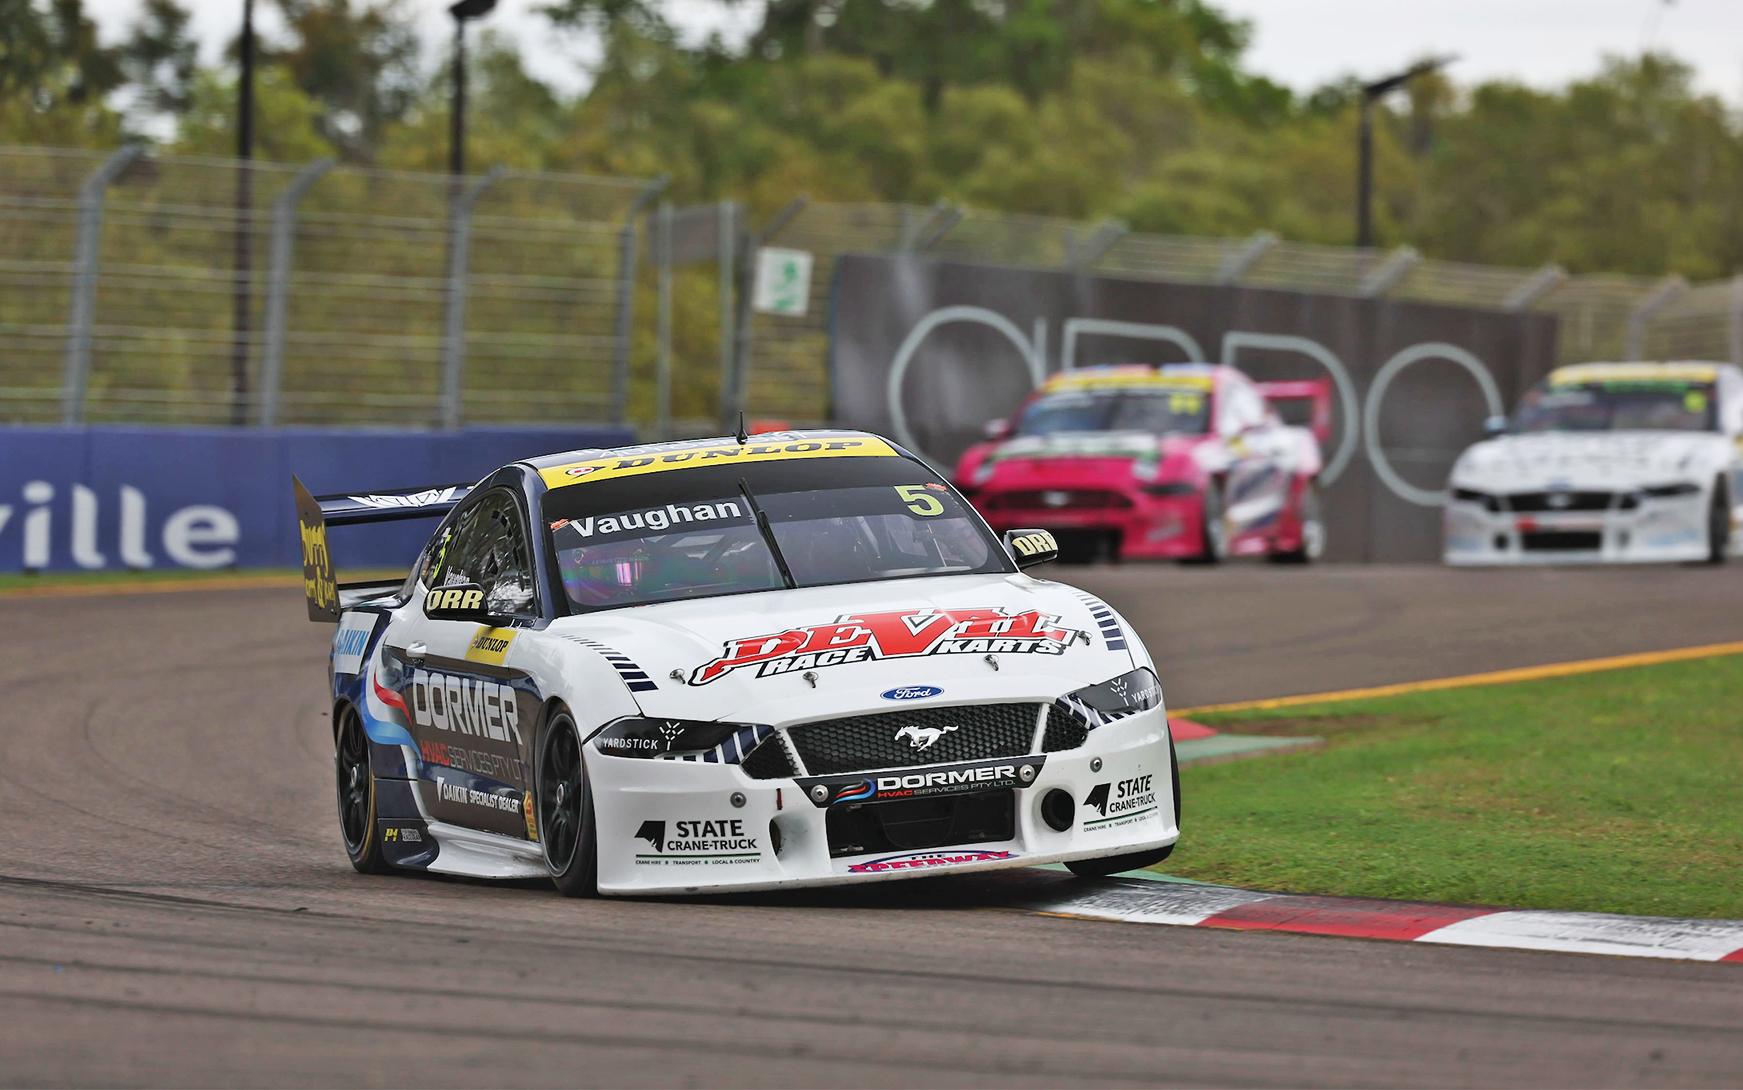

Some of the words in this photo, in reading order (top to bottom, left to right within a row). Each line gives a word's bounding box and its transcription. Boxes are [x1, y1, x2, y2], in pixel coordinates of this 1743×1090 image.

[613, 441, 863, 470] DUNLOP
[894, 485, 944, 517] 5
[570, 501, 741, 538] Vaughan
[426, 589, 484, 611] ORR
[475, 636, 509, 653] DUNLOP
[936, 639, 1064, 655] KARTS
[763, 647, 869, 677] RACE
[893, 686, 934, 700] Ford
[412, 668, 523, 745] DORMER
[602, 737, 659, 750] YARDSTICK
[877, 765, 1016, 791] DORMER
[970, 782, 992, 790] PTY
[1117, 774, 1153, 798] STATE
[469, 789, 499, 809] SPECIALIST
[498, 796, 519, 813] DEALER
[1109, 792, 1157, 813] CRANE-TRUCK
[676, 820, 744, 838] STATE
[667, 838, 757, 851] CRANE-TRUCK
[848, 850, 1010, 873] SPEEDWAY
